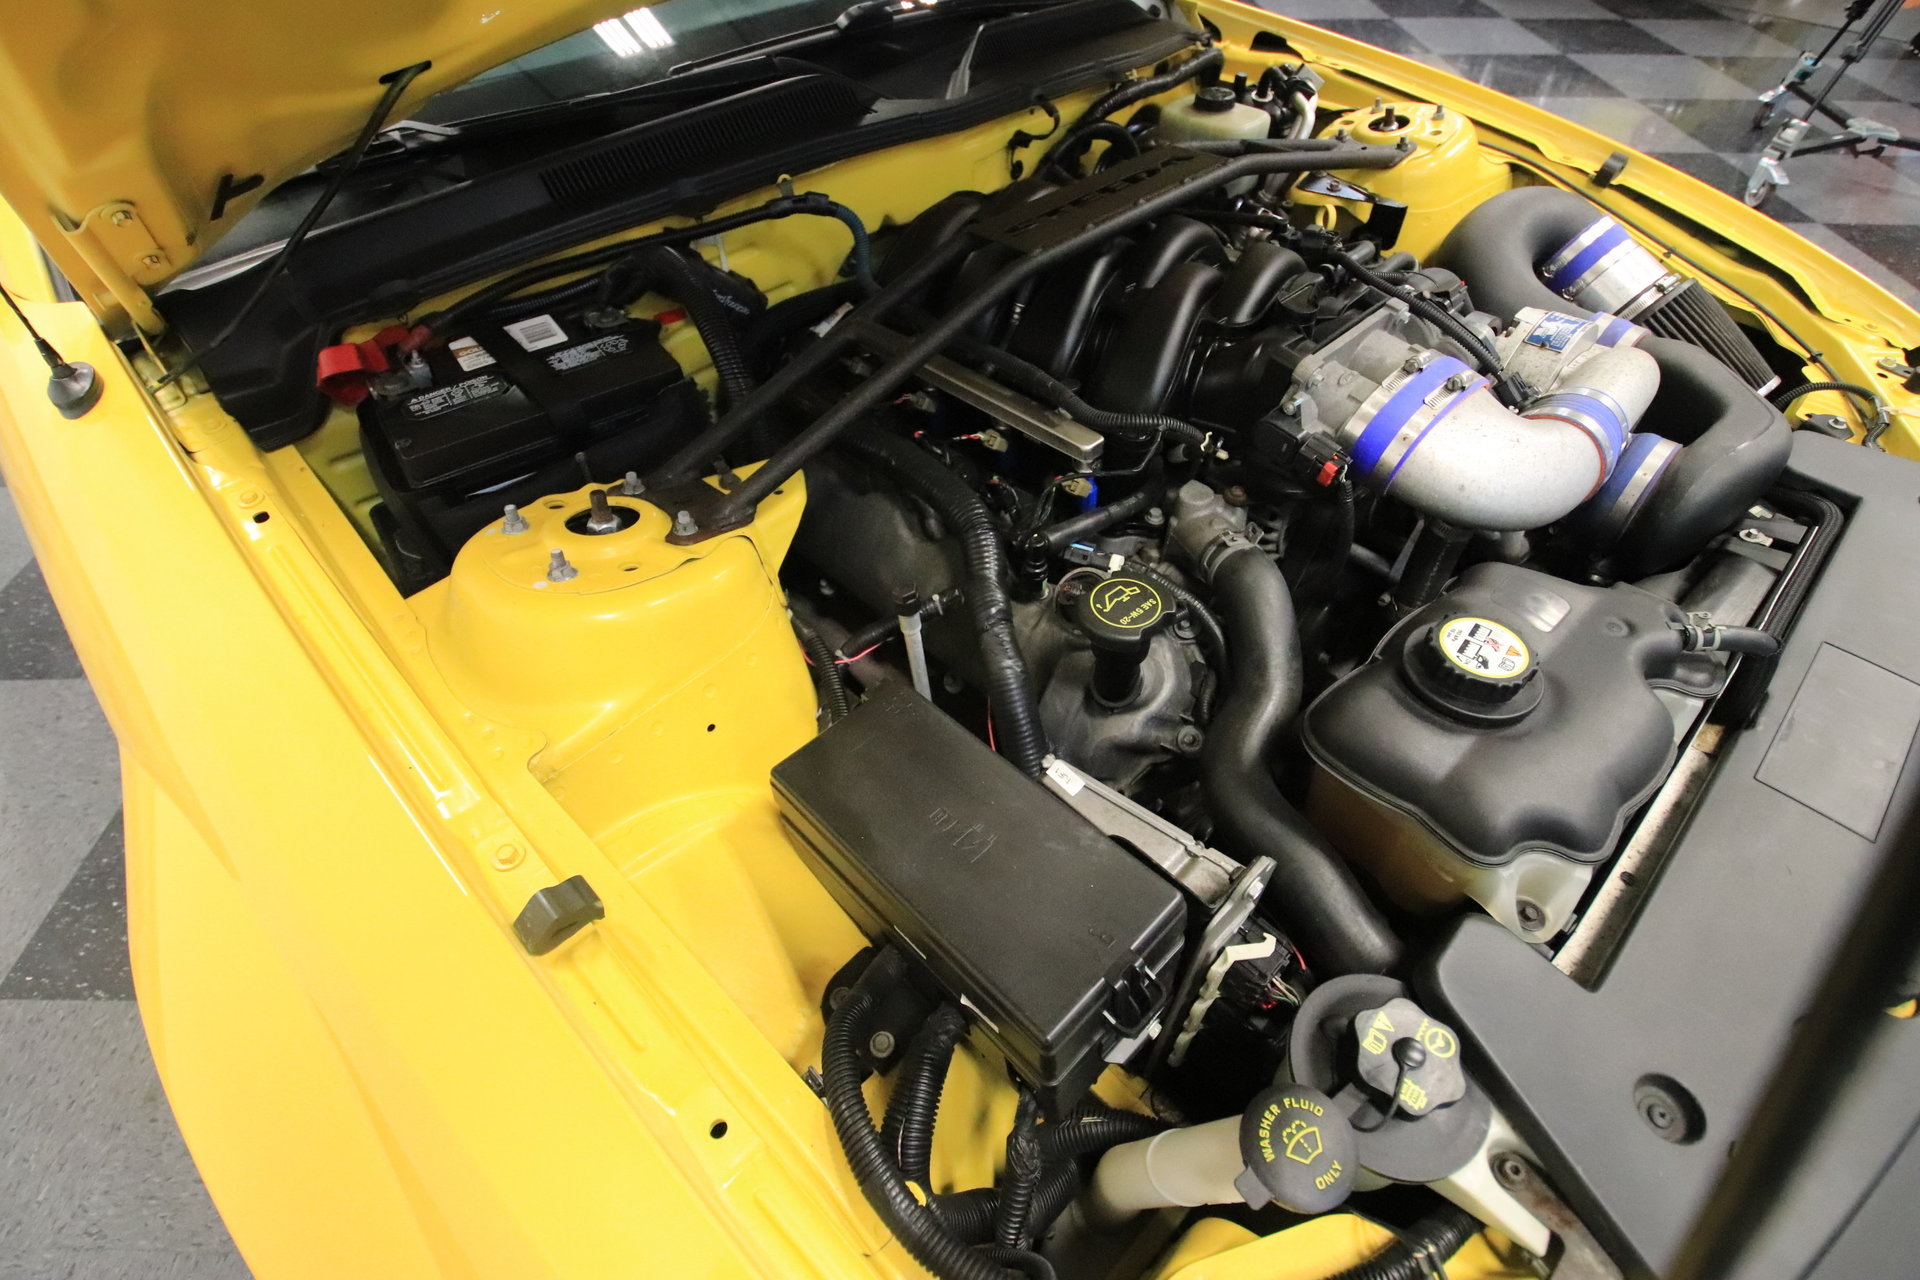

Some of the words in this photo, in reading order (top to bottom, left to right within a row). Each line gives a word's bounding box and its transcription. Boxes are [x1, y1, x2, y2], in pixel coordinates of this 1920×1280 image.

[418, 386, 451, 400] DANGER
[1141, 598, 1157, 611] SAE
[1120, 607, 1144, 625] 5W-20
[1259, 1104, 1281, 1162] WASHER
[1283, 1097, 1324, 1117] FLUID
[1315, 1159, 1342, 1190] ONLY
